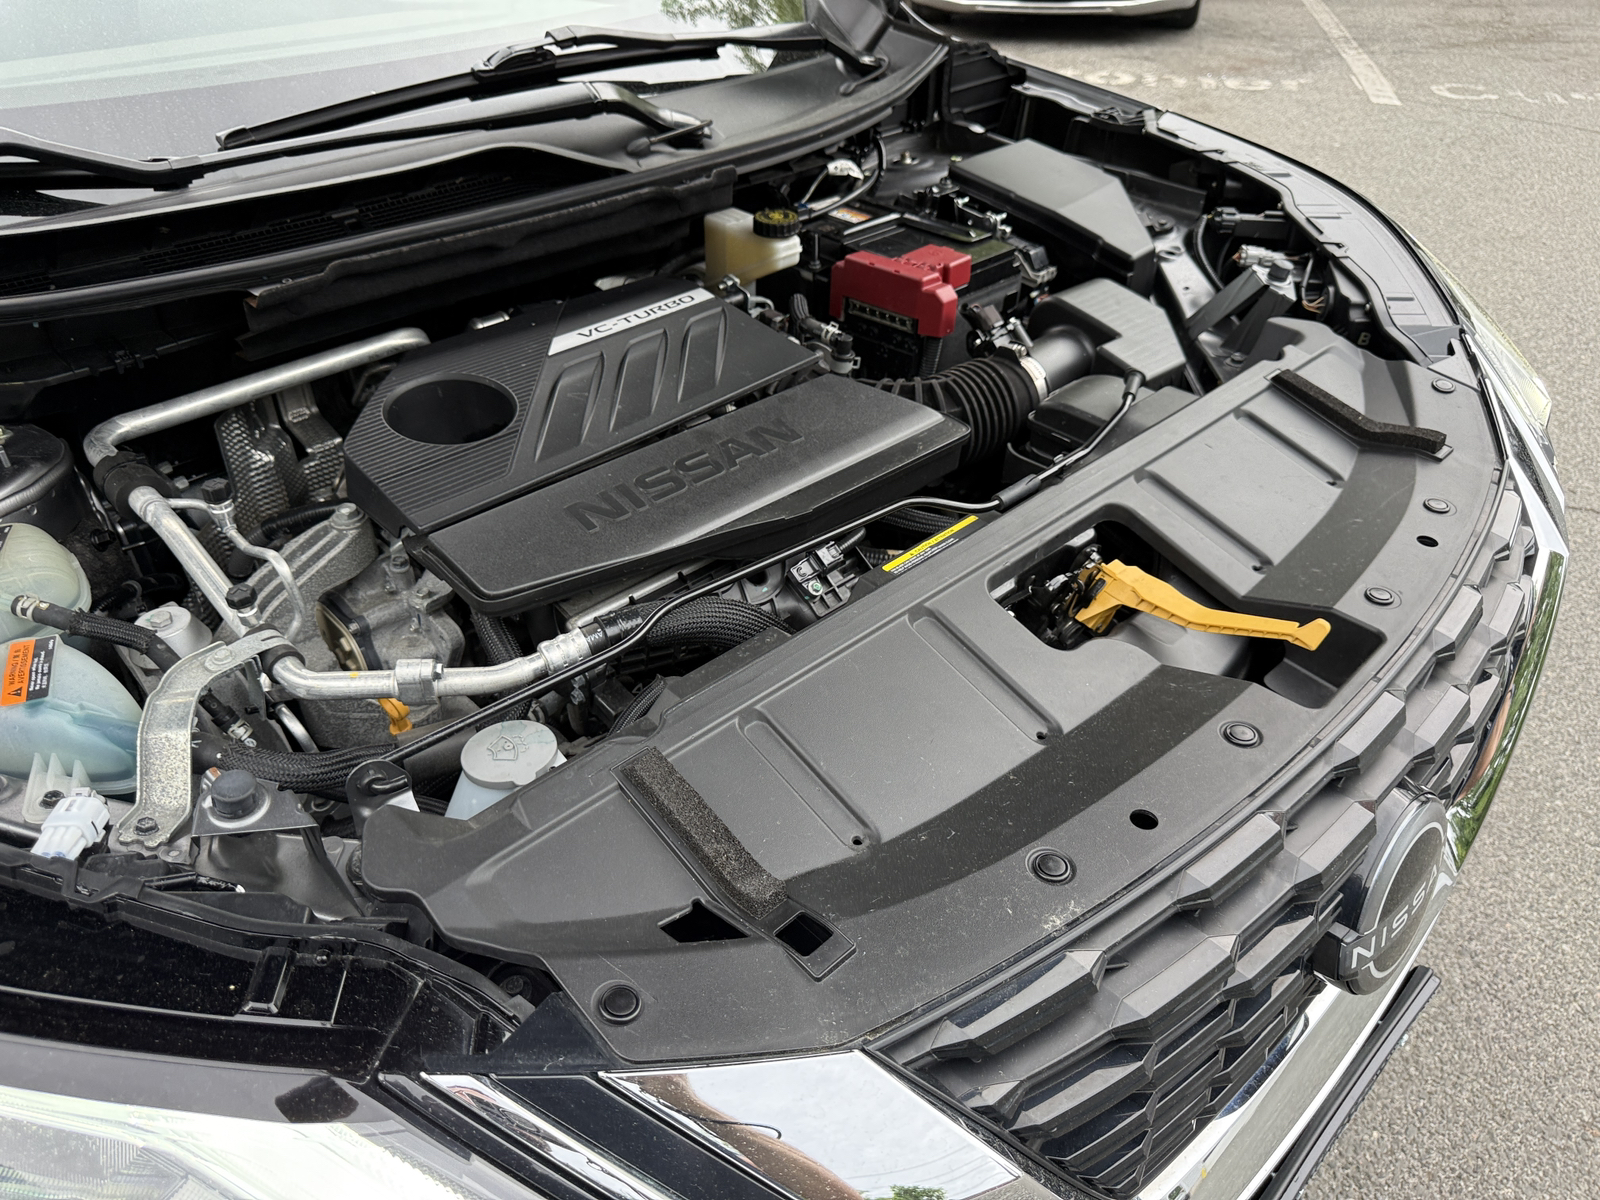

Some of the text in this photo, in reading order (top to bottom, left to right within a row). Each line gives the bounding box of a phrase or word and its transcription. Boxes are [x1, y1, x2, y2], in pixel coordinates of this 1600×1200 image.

[576, 295, 695, 338] VC-TURBO
[563, 417, 803, 533] NISSAN
[1351, 864, 1438, 969] NISSA
